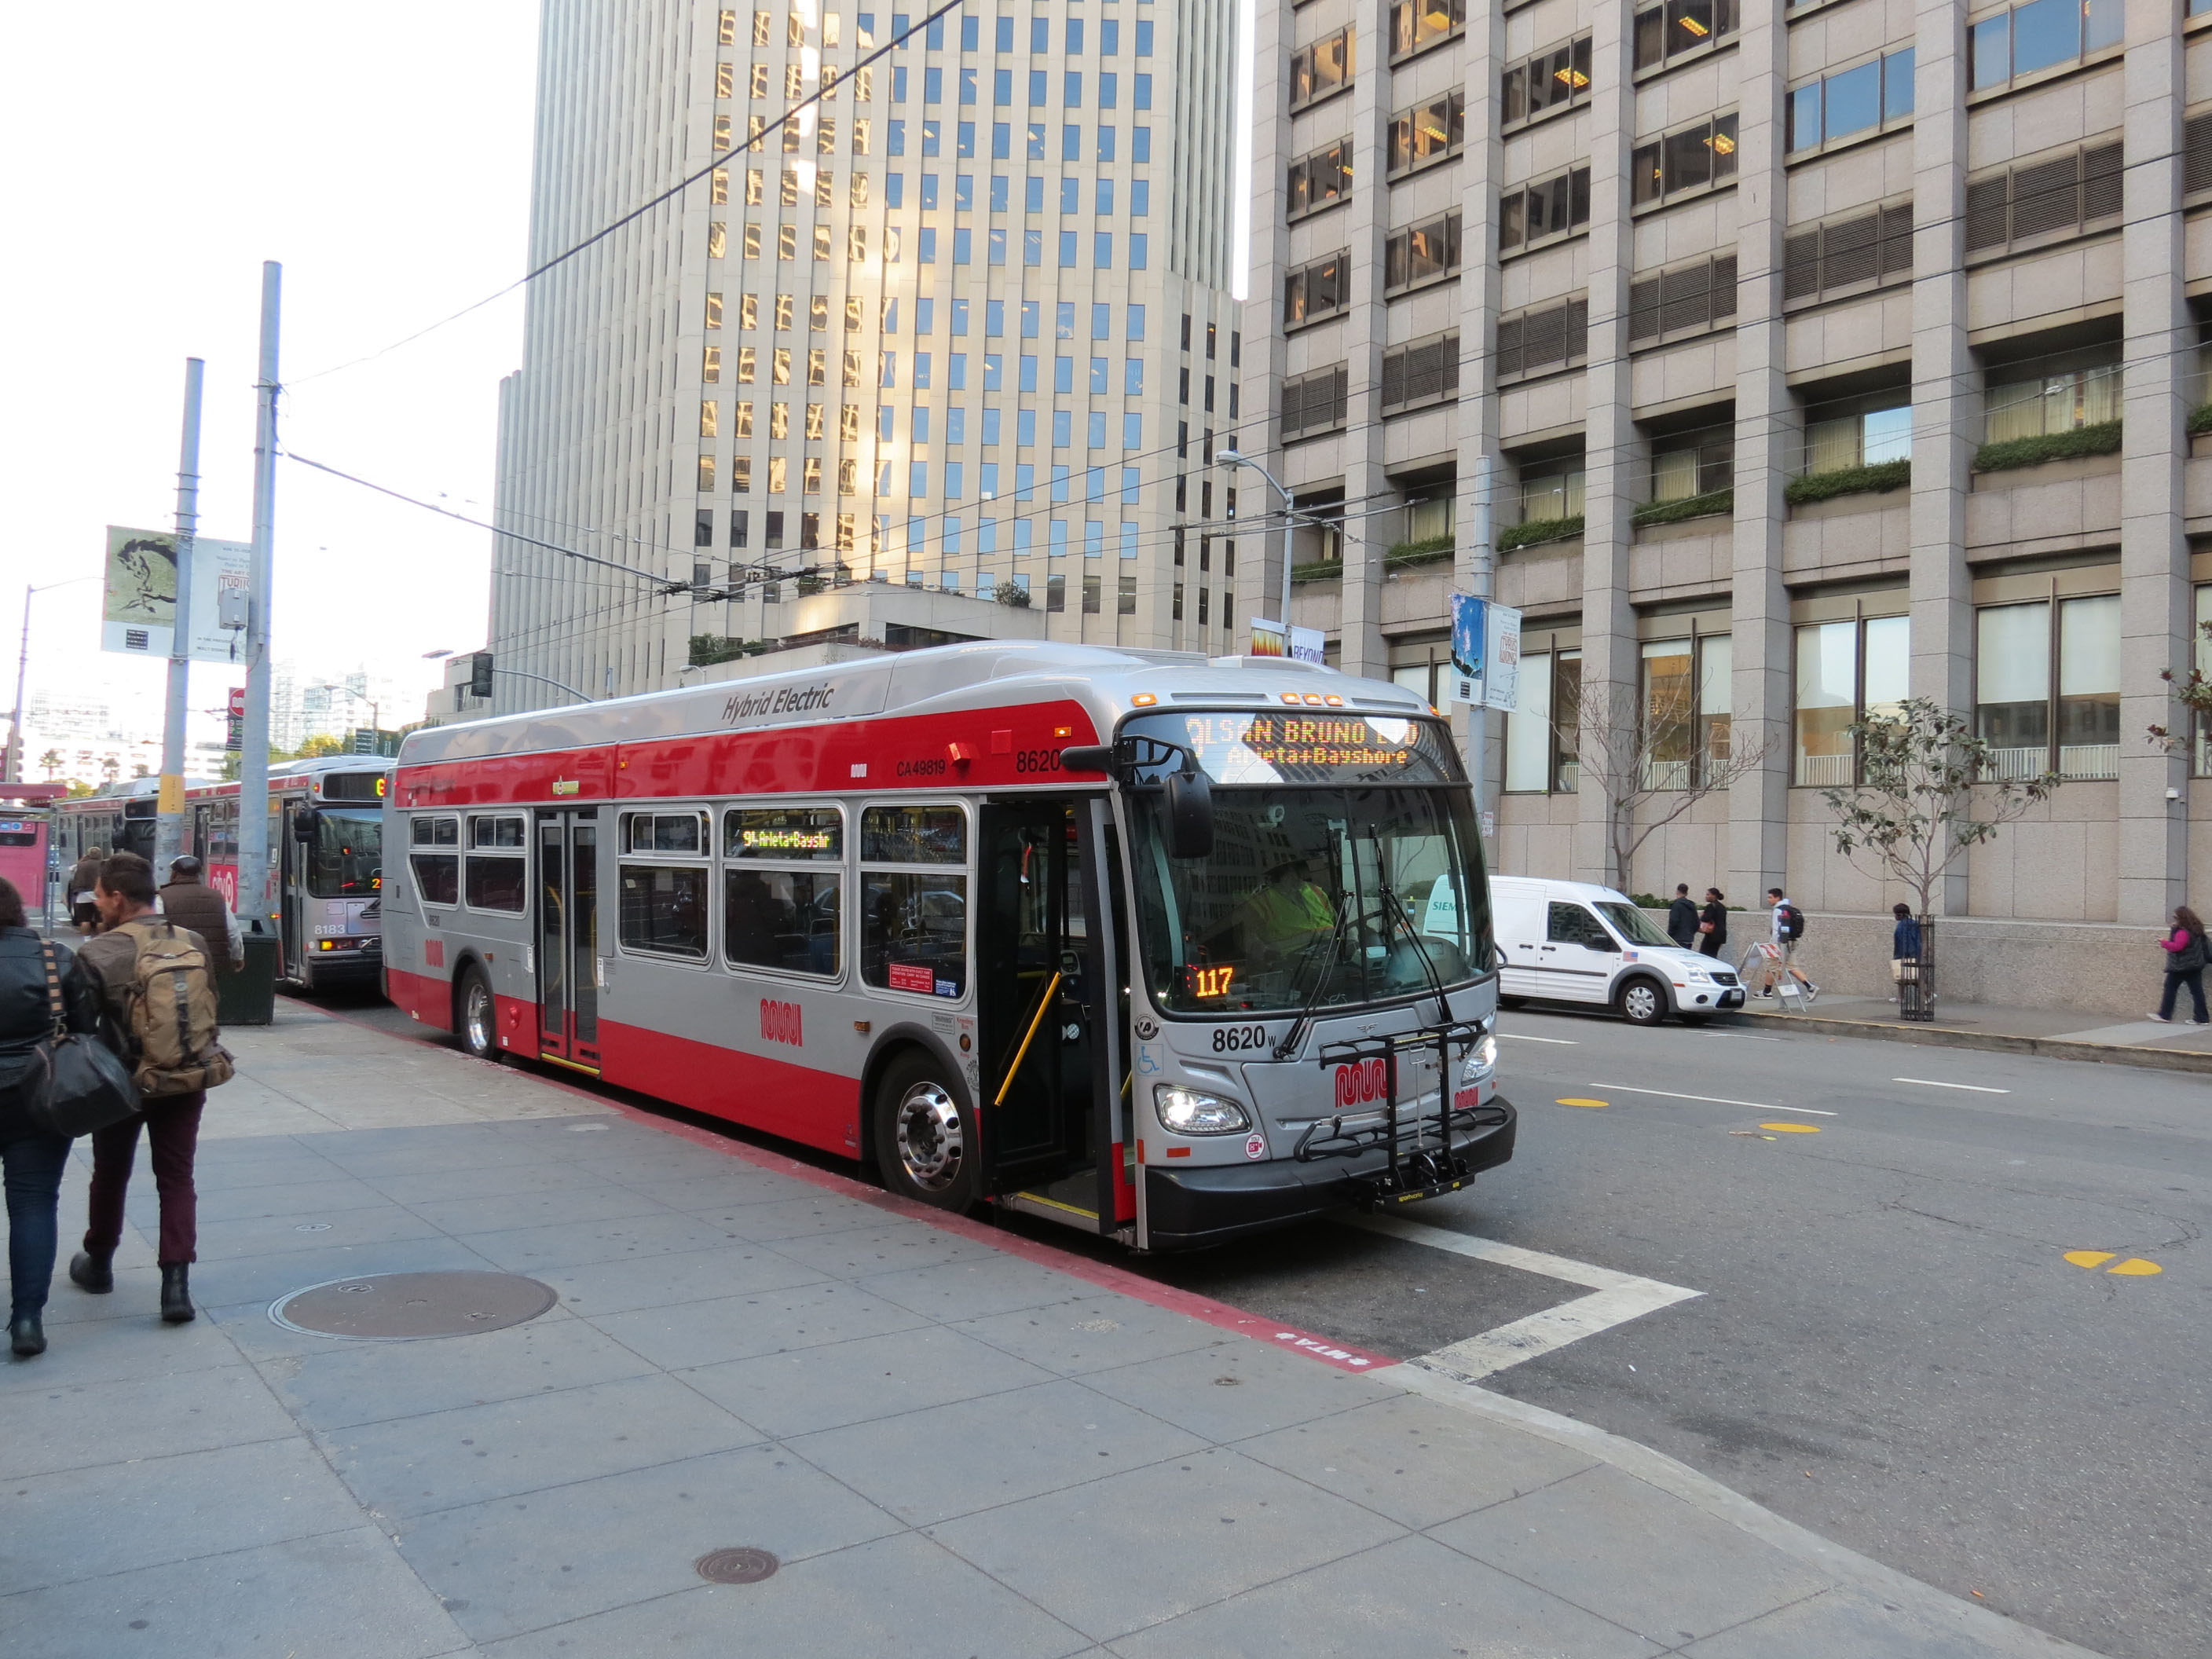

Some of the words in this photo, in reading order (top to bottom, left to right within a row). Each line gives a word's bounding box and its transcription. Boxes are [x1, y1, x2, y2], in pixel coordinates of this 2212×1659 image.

[722, 690, 775, 724] Hybrid
[771, 683, 834, 714] Electric
[1219, 719, 1273, 743] SAN
[1284, 720, 1366, 744] BRUNO
[896, 760, 946, 777] CA49819
[1016, 749, 1060, 773] 8620
[1432, 901, 1456, 911] SIEM
[314, 924, 346, 935] 8183
[1196, 967, 1234, 998] 117
[1212, 1025, 1265, 1053] 8620
